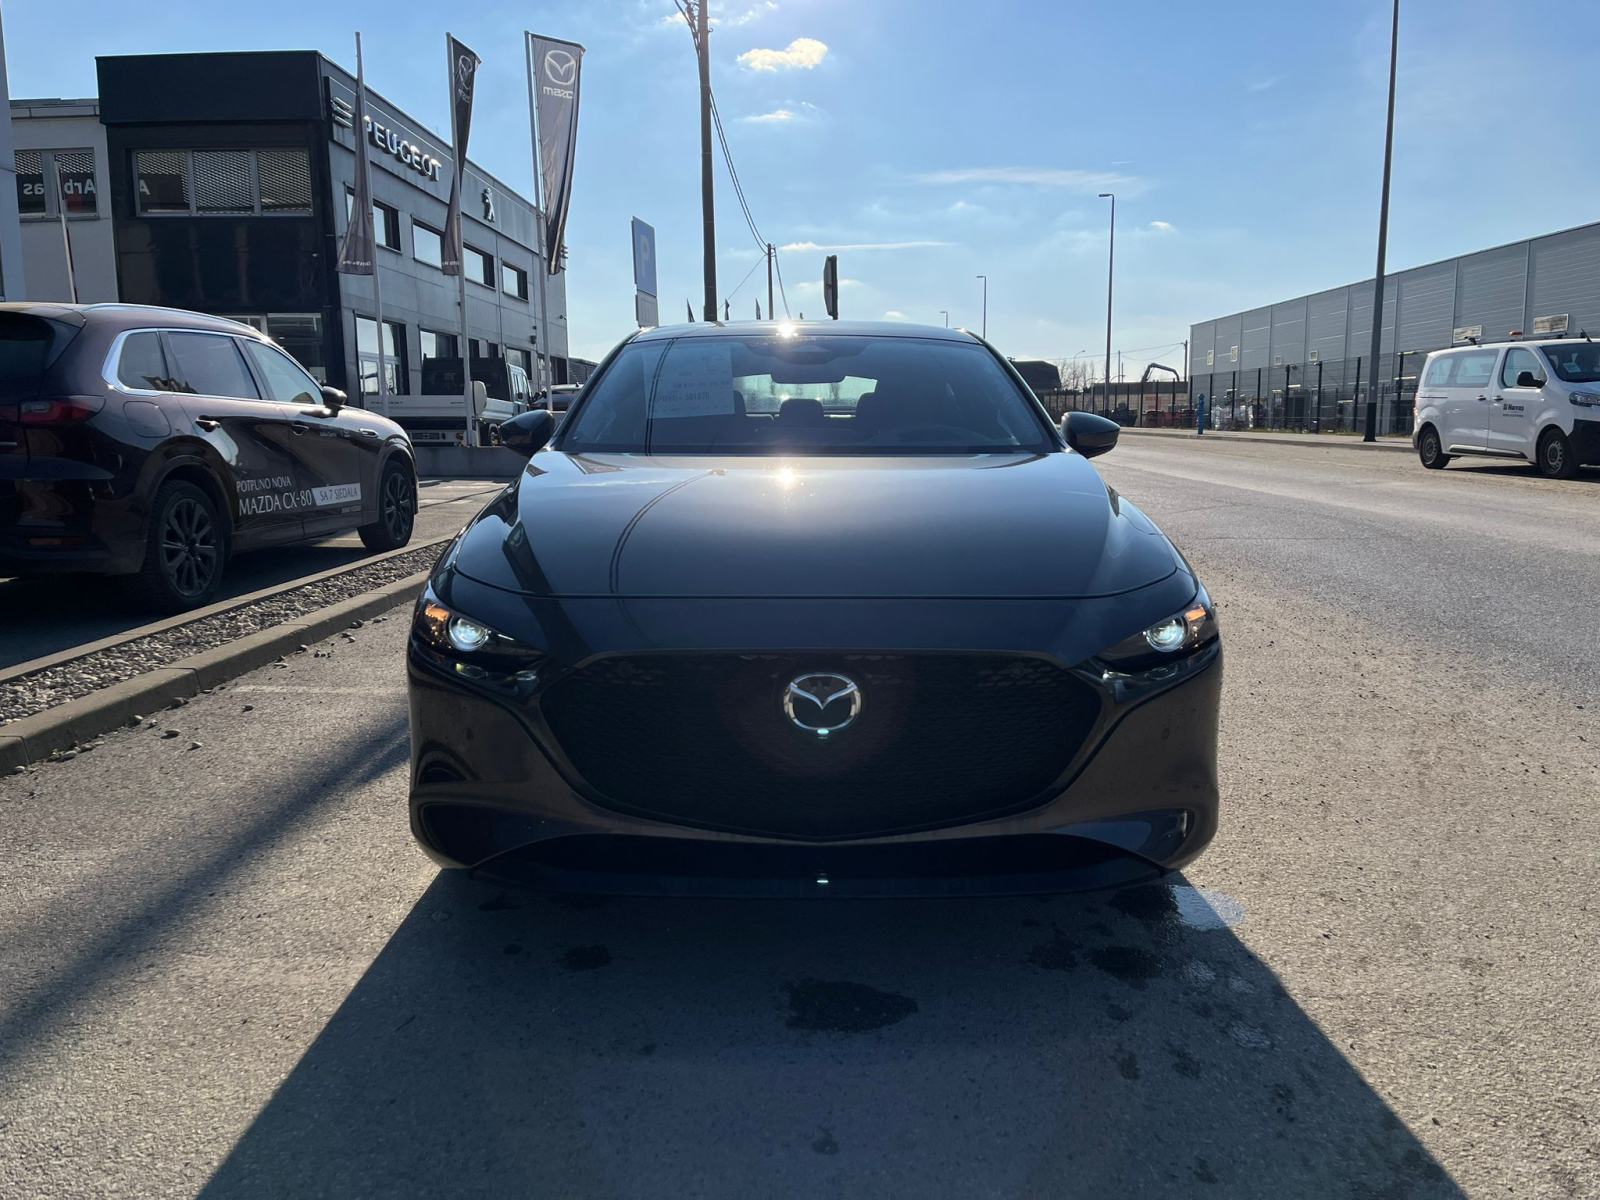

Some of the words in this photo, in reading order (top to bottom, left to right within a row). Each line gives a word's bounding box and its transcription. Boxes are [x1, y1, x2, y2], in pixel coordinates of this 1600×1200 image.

[640, 234, 650, 277] P
[236, 478, 271, 493] POTPUNO
[272, 476, 292, 488] NOVA
[319, 489, 329, 501] SA
[239, 494, 282, 516] MAZDA
[283, 489, 313, 509] CX-80
